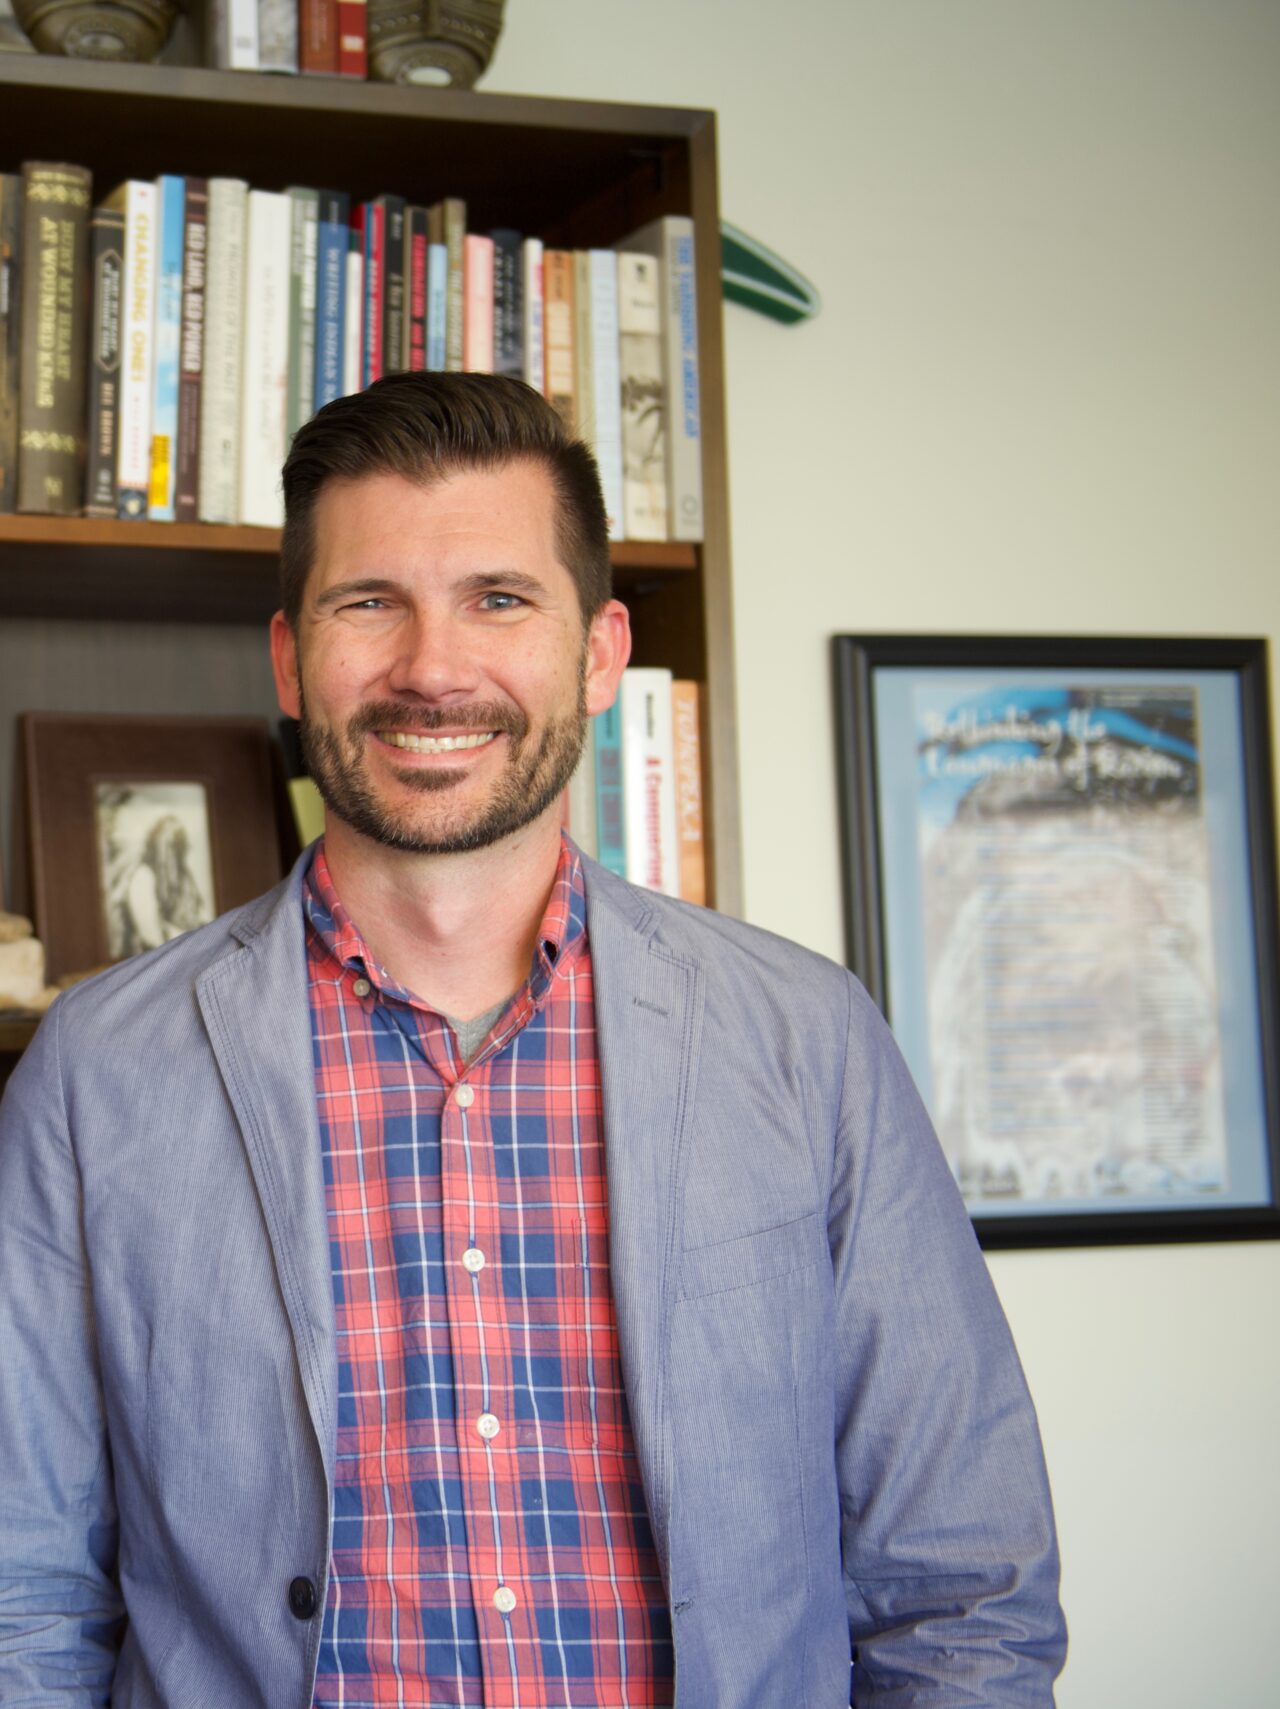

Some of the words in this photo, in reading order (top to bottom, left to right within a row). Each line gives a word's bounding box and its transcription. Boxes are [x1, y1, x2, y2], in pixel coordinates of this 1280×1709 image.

[39, 216, 58, 243] AT
[188, 222, 207, 251] RED
[182, 251, 206, 291] LAND,
[37, 246, 57, 348] WOUNDED
[185, 292, 204, 320] RED
[182, 321, 203, 372] POWER
